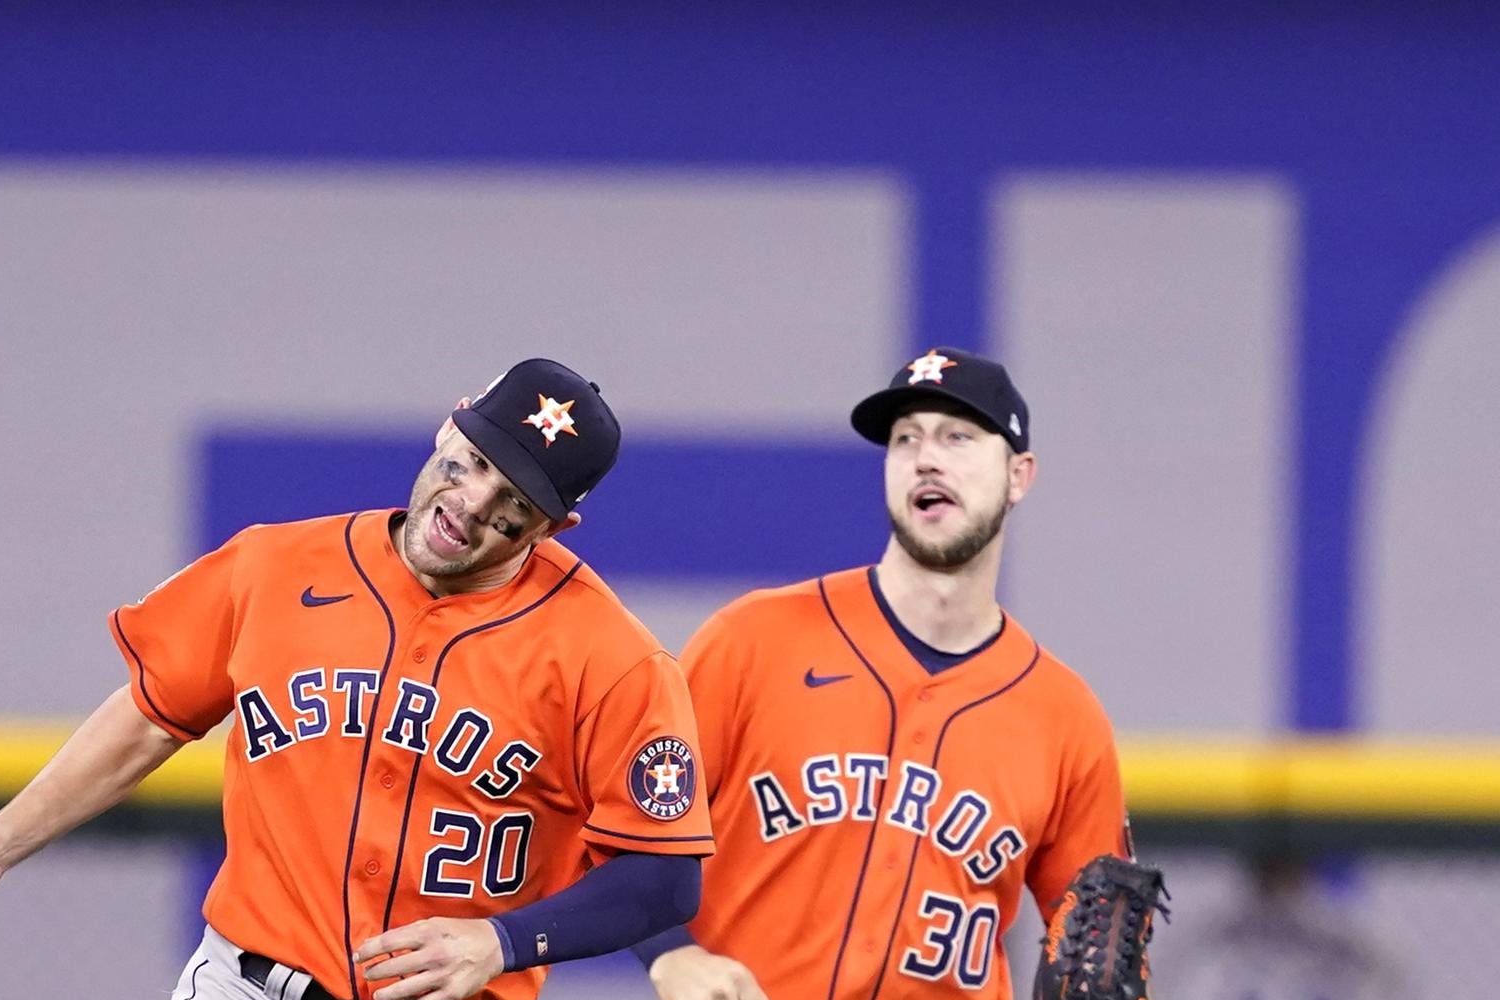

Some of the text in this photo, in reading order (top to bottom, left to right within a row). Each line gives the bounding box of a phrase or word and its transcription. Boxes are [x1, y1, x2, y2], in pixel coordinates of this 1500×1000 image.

[236, 666, 544, 800] ASTROS
[638, 739, 692, 765] HOUSTON
[418, 807, 535, 899] 20
[640, 794, 691, 817] ASTROS
[749, 751, 1029, 885] ASTROS
[899, 889, 1001, 991] 30
